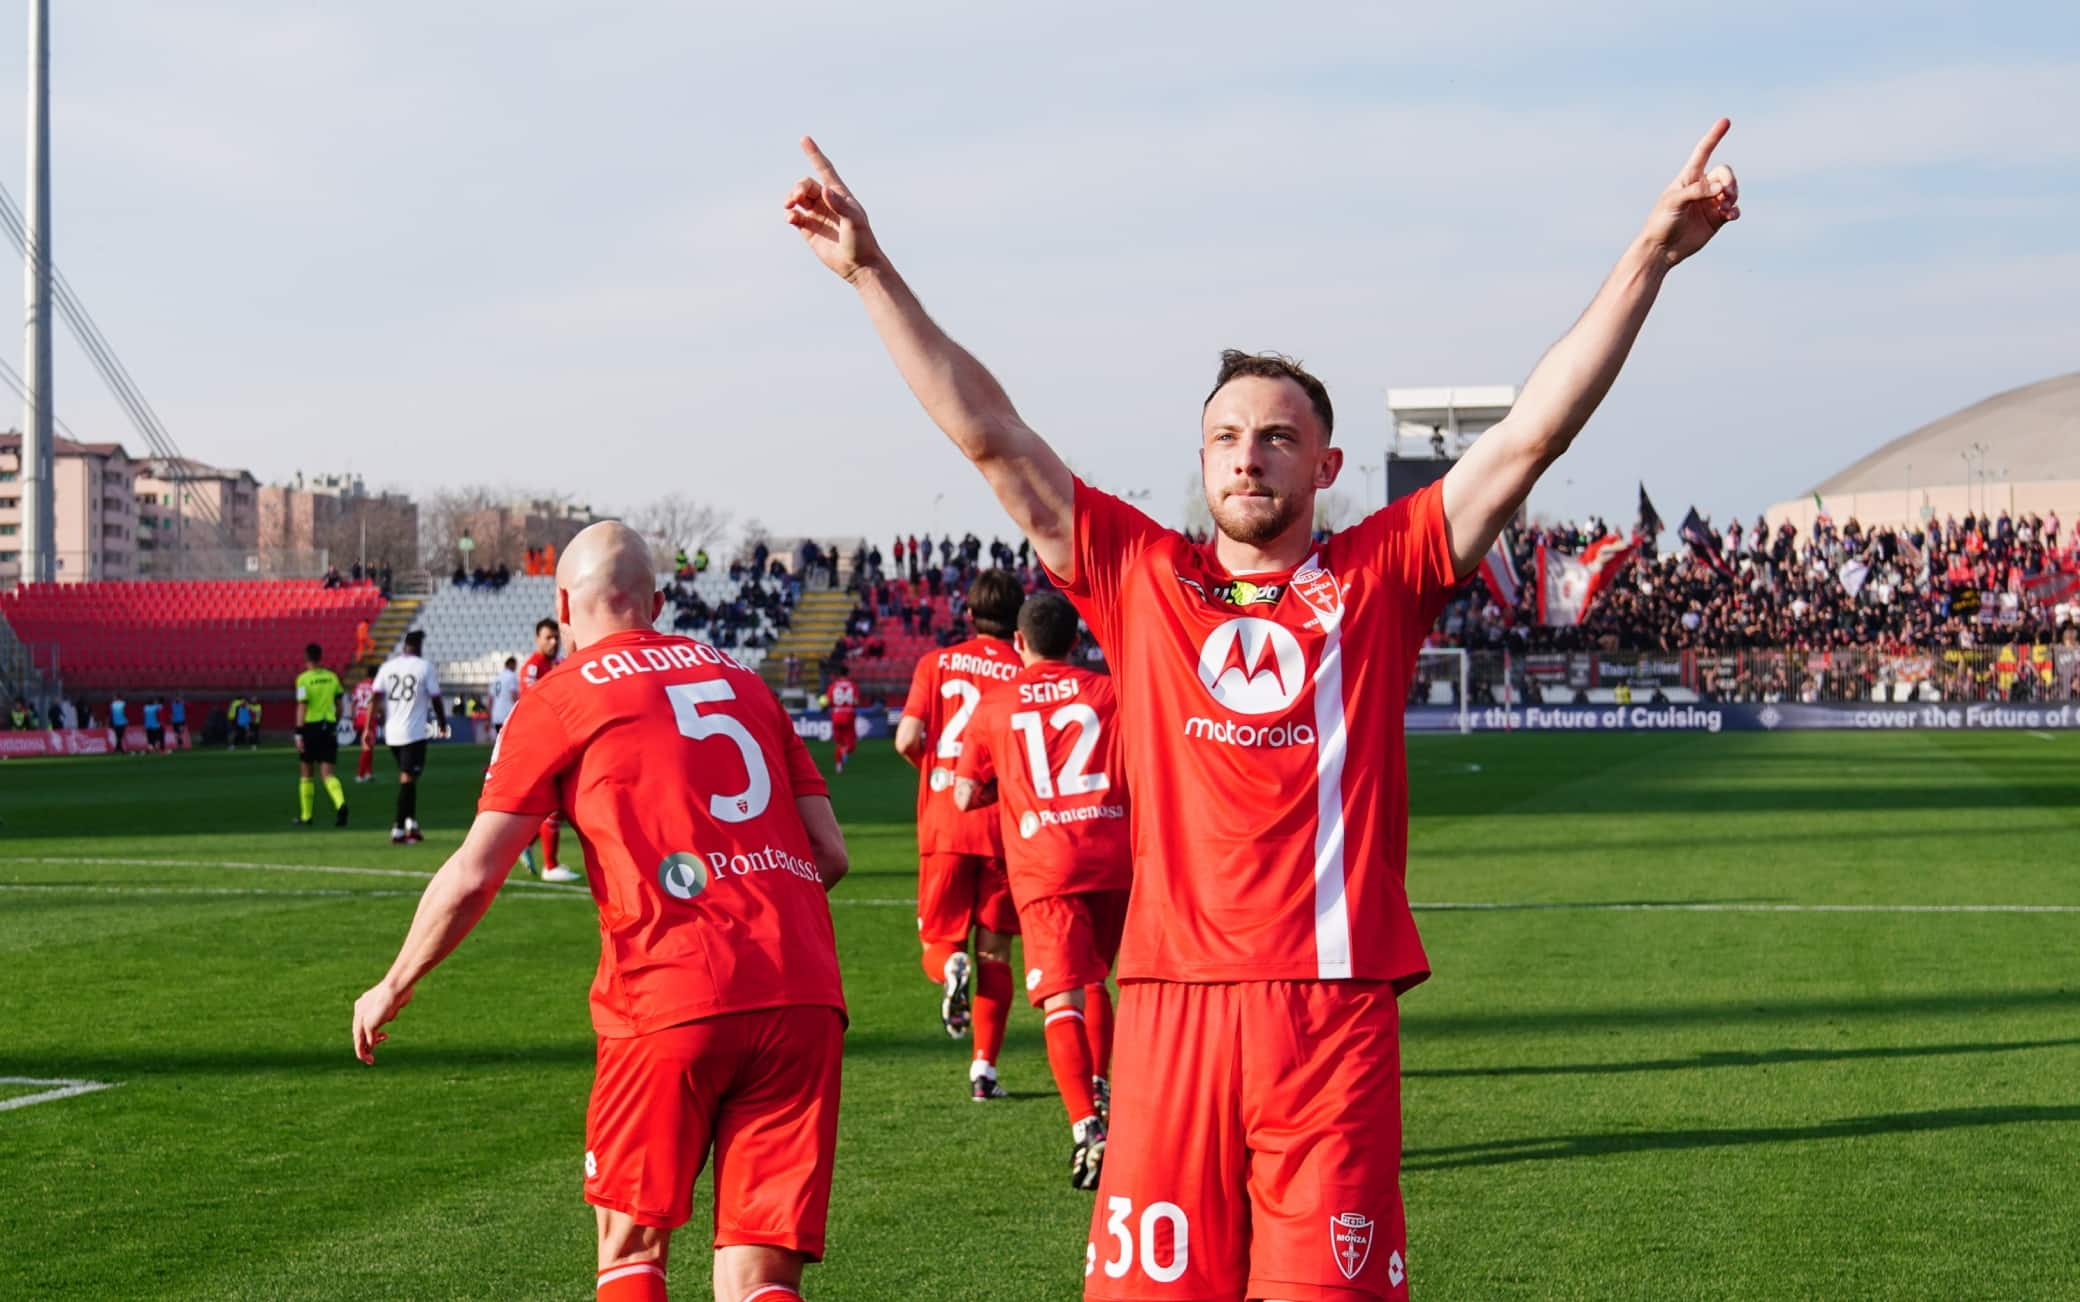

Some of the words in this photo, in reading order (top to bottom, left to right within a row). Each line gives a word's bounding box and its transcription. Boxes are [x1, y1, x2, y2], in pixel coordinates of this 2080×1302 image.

[389, 673, 417, 702] 28
[1018, 678, 1080, 703] SENSI
[1484, 707, 1521, 729] the
[1526, 707, 1599, 729] Future
[1602, 706, 1626, 728] of
[1631, 706, 1722, 733] Cruising
[1924, 704, 1961, 728] the
[1966, 705, 2039, 728] Future
[2045, 705, 2071, 728] of
[1185, 716, 1315, 748] motorola
[665, 678, 771, 823] 5
[1011, 703, 1110, 800] 12
[1104, 1195, 1189, 1283] 30
[1336, 1233, 1367, 1244] MONZA
